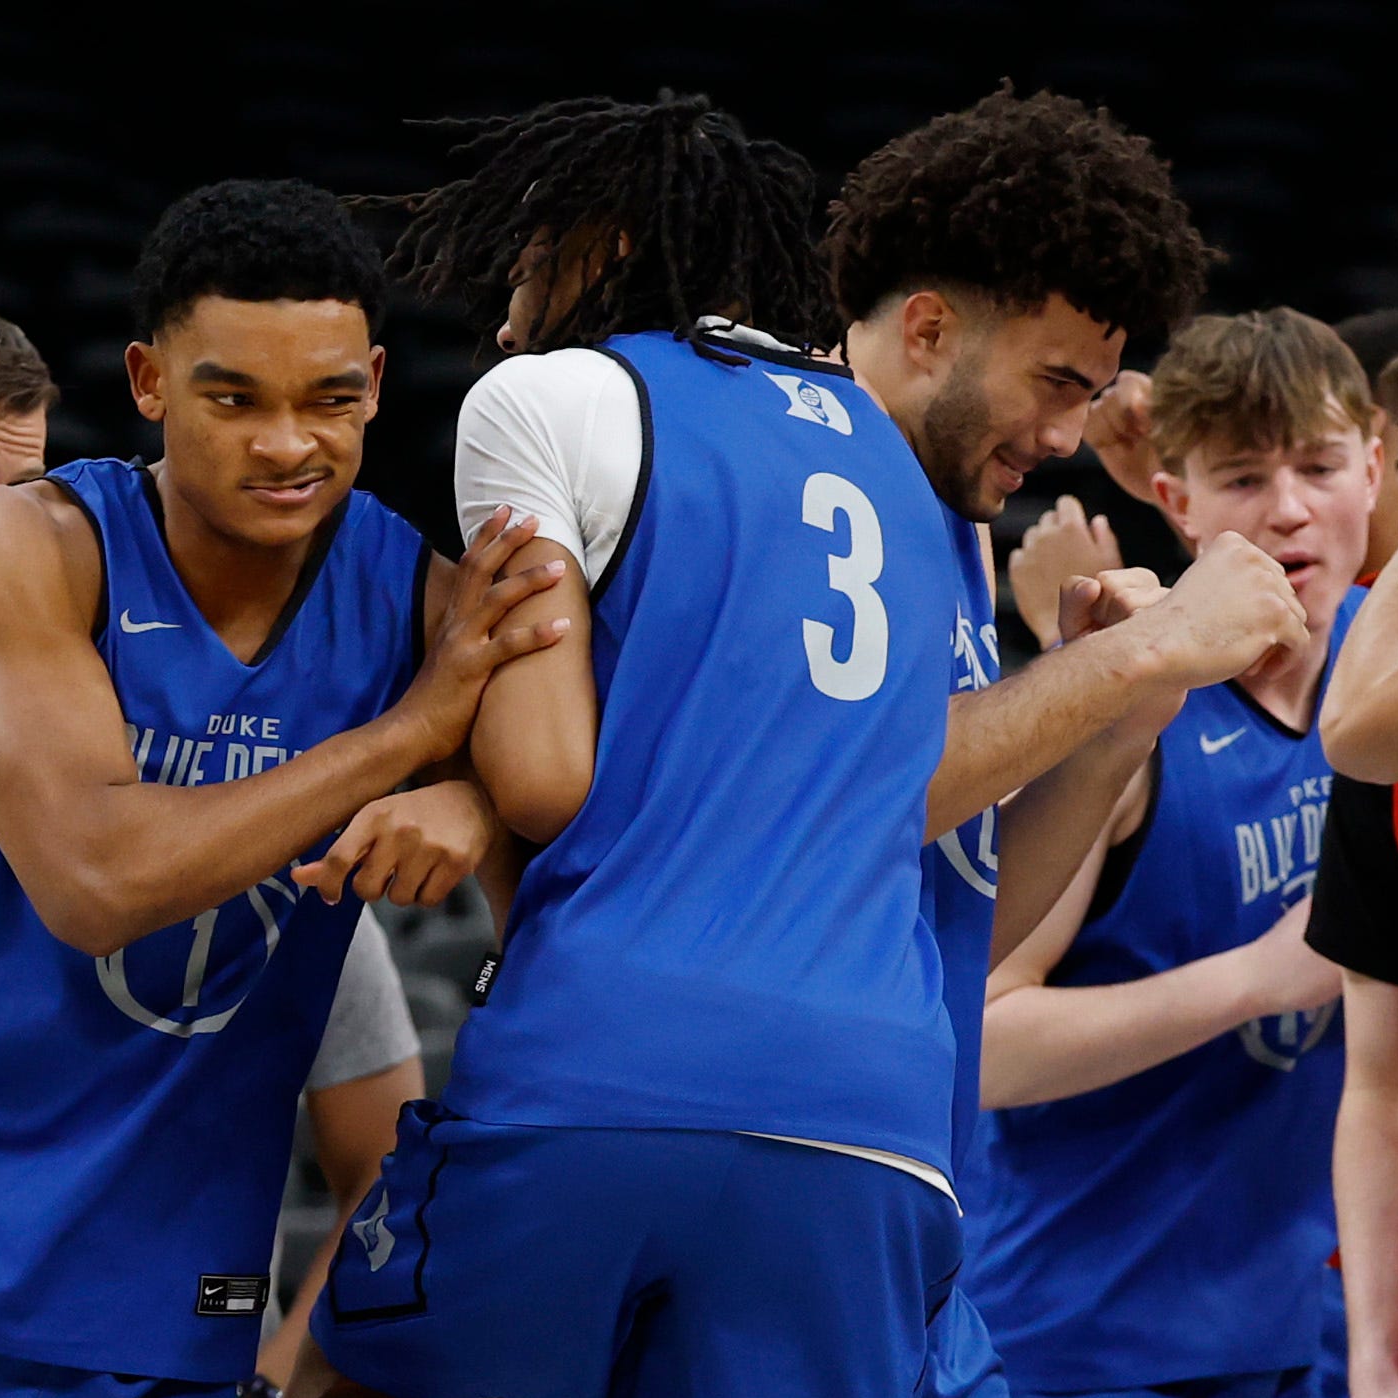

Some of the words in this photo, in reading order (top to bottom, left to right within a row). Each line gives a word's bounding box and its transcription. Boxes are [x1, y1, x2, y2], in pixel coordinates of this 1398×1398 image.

[802, 472, 890, 702] 3
[206, 714, 281, 740] DUKE
[475, 959, 497, 993] MENS
